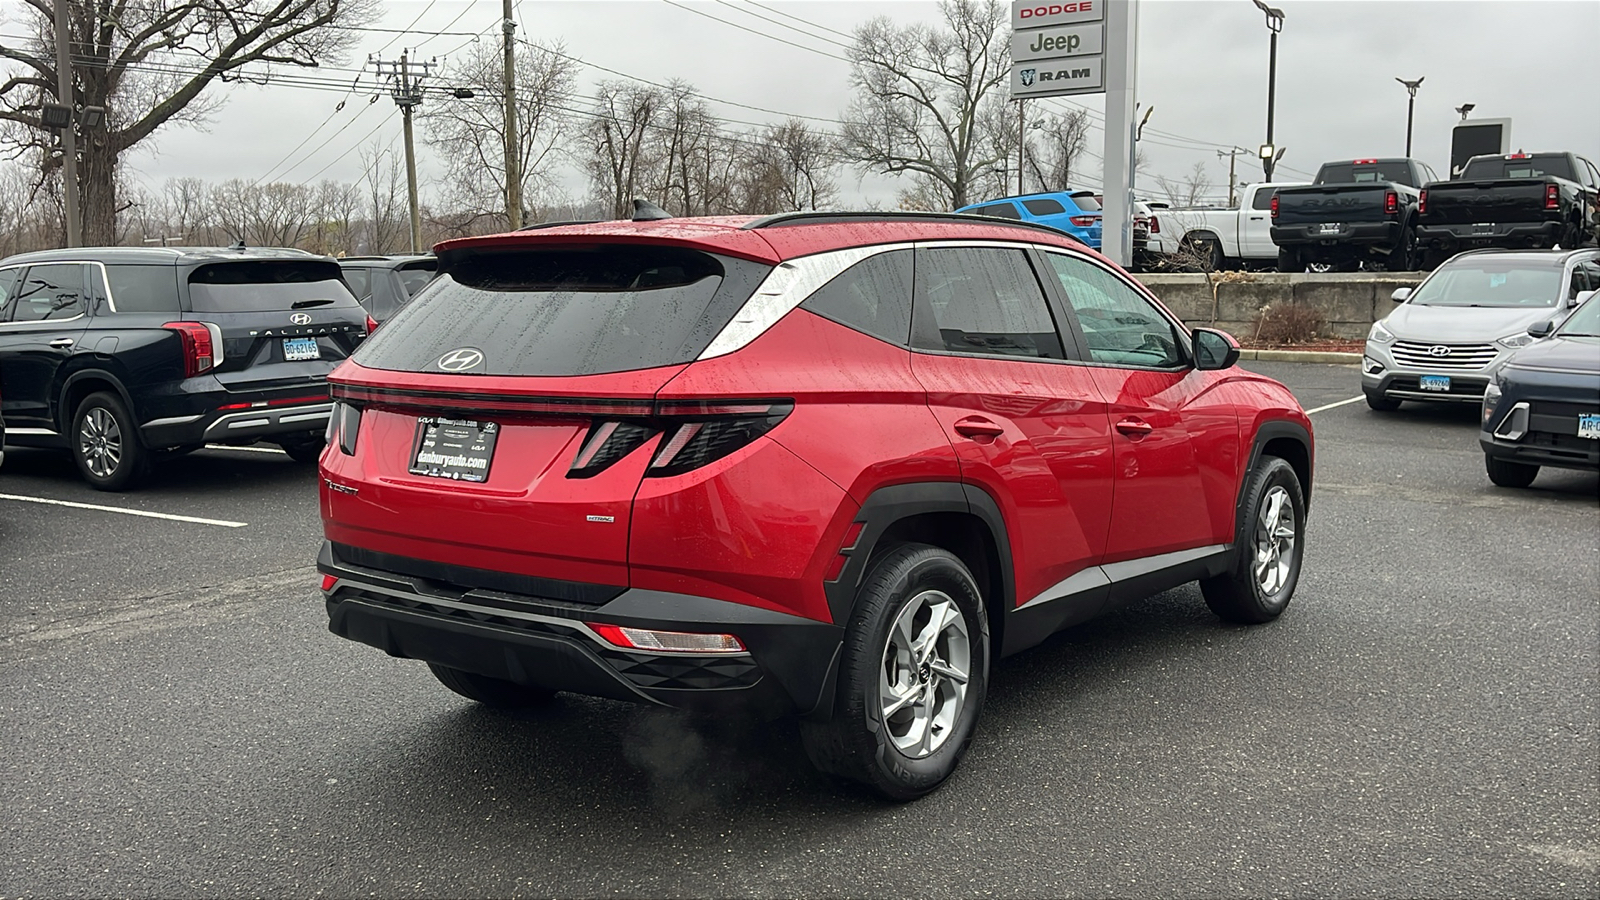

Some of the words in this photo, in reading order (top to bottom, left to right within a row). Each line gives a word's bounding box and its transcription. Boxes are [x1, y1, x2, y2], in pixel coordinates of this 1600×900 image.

[1020, 1, 1092, 19] DODGE
[1030, 33, 1080, 53] Jeep
[1039, 68, 1091, 82] RAM
[249, 326, 349, 336] PALISADE
[417, 451, 487, 469] danburyauto.com
